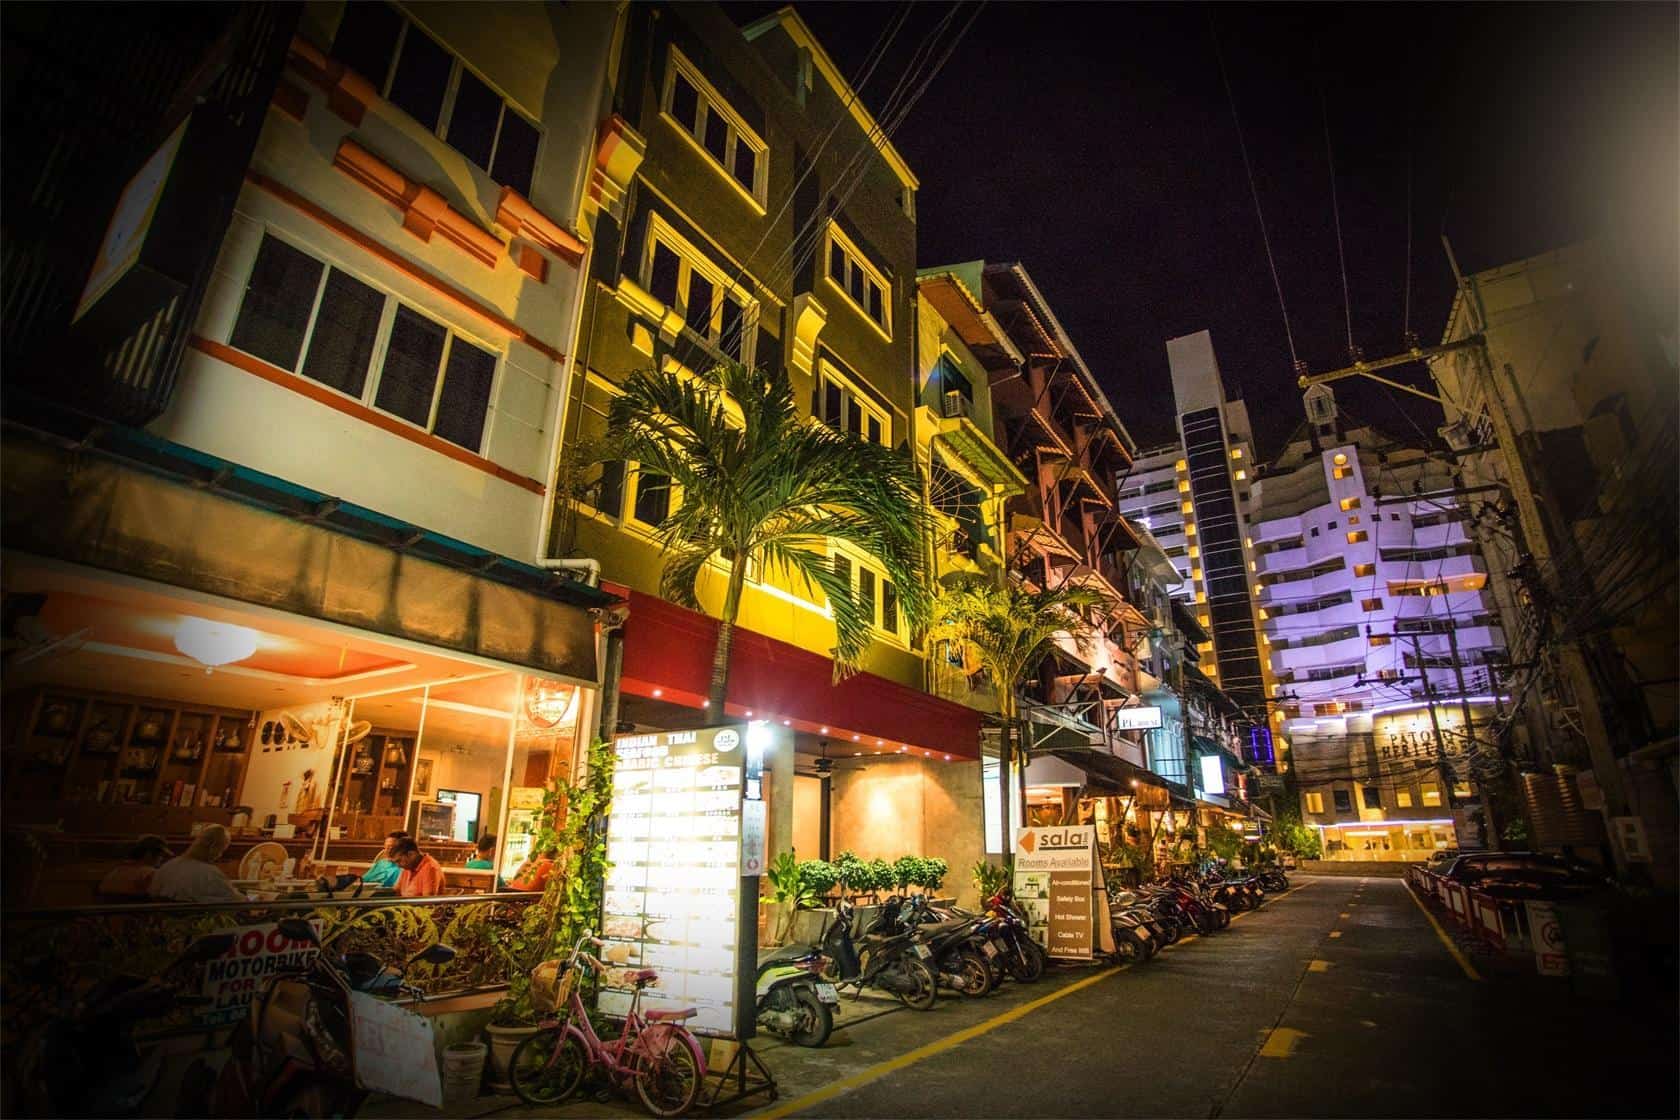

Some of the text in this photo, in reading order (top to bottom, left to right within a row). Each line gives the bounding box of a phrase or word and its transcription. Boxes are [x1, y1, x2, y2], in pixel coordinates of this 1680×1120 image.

[668, 731, 697, 744] THAI
[1390, 729, 1455, 746] PATOG
[1382, 740, 1469, 760] HERITGE
[1040, 829, 1082, 846] sala
[1018, 856, 1089, 868] Rooms Available
[1075, 931, 1084, 939] TV
[218, 978, 255, 995] FOR
